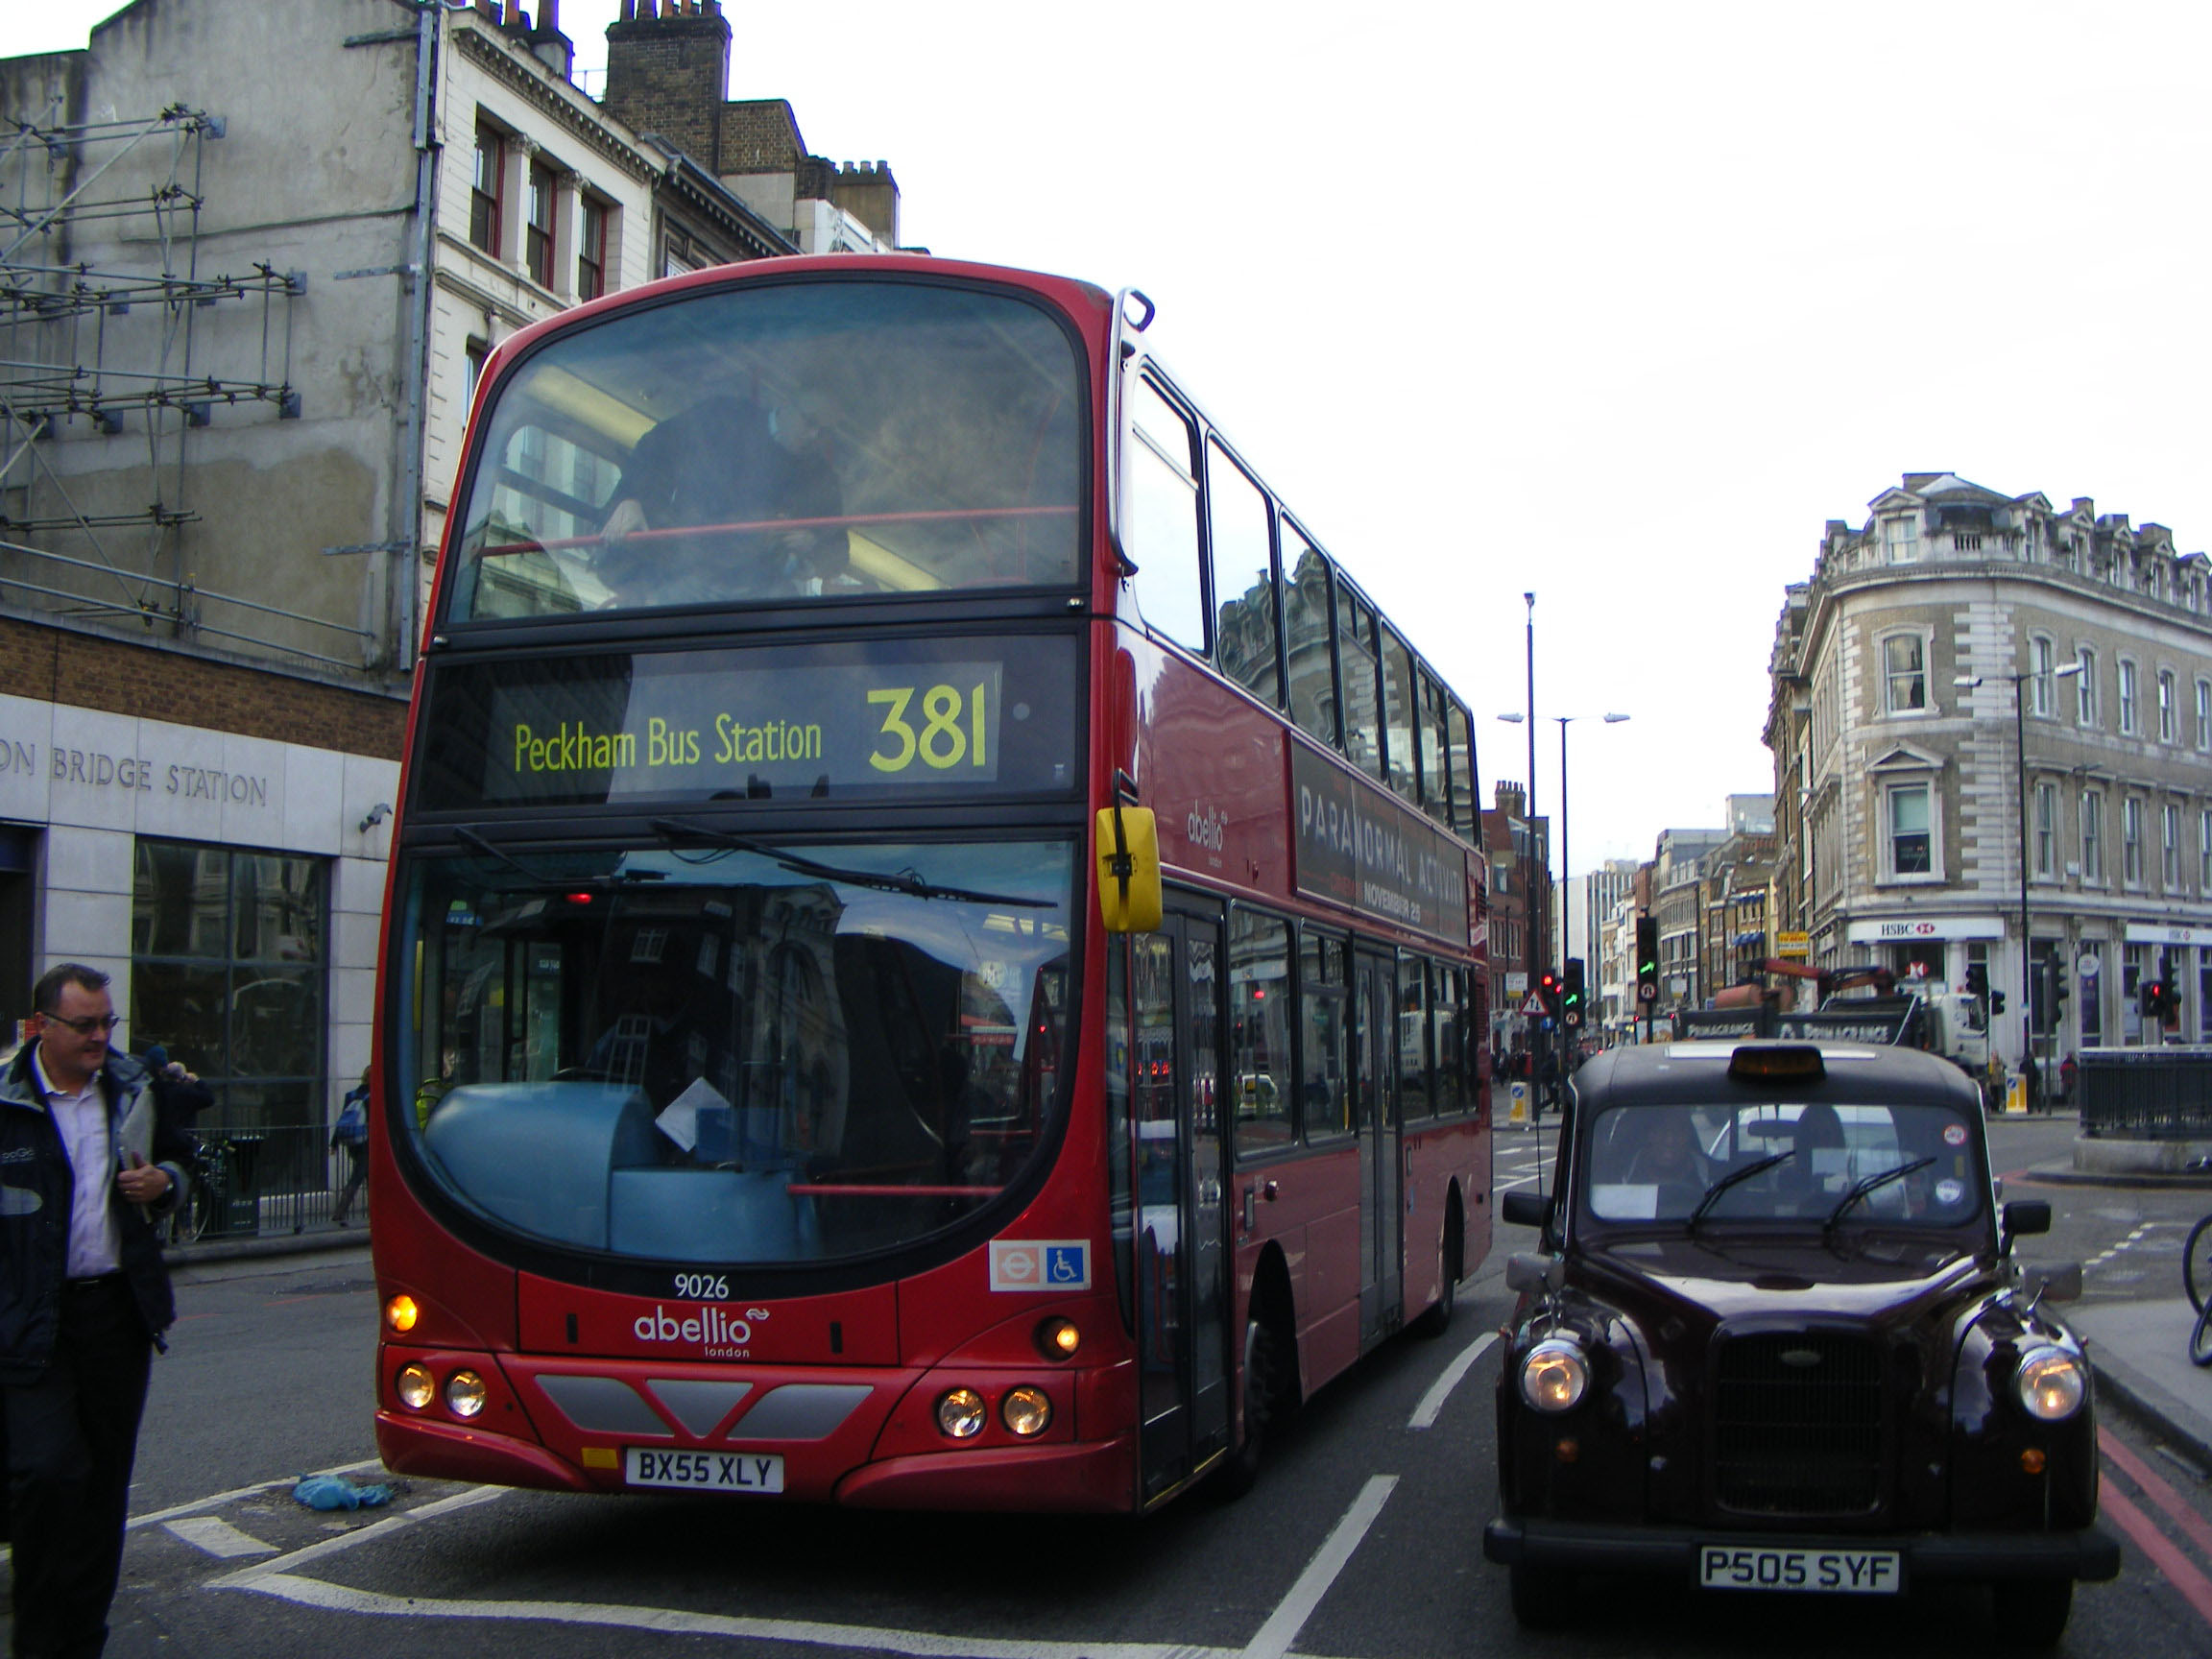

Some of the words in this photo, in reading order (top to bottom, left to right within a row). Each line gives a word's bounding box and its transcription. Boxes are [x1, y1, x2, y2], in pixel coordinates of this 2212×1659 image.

[515, 722, 636, 772] Peckham
[648, 717, 700, 766] Bus
[714, 711, 822, 764] Station
[867, 682, 986, 773] 381
[52, 747, 152, 792] BRIDGE
[166, 763, 267, 807] STATION
[1188, 798, 1223, 853] abellio
[1301, 784, 1412, 885] PARANORMAL
[1418, 851, 1464, 907] ACTIVITY
[1363, 880, 1409, 920] NOVEMBER
[1882, 923, 1914, 936] HSBC
[674, 1273, 730, 1299] 9026
[634, 1305, 752, 1345] abellio
[704, 1346, 750, 1358] london
[639, 1452, 709, 1482] BX55
[718, 1456, 771, 1487] XLY
[1705, 1550, 1806, 1585] P505
[1818, 1555, 1893, 1587] SYF
